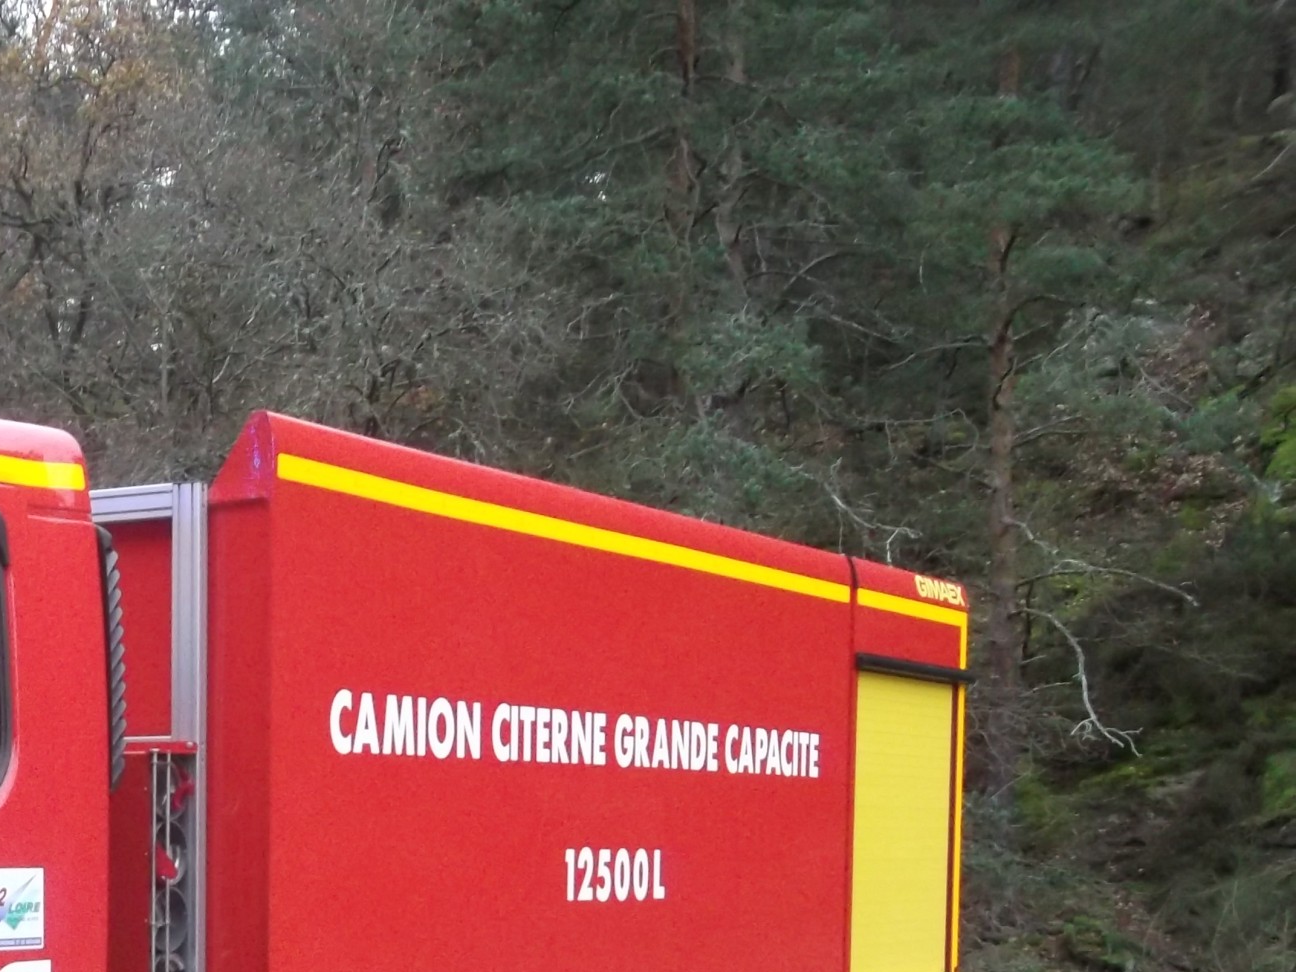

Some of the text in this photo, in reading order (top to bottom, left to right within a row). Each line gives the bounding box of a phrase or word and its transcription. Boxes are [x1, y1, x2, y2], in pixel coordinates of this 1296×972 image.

[914, 575, 965, 607] GIMAEX
[329, 688, 820, 778] CAMION CITERNE GRANDE CAPACITE
[564, 846, 666, 902] 12500L
[7, 901, 41, 914] LOIRE
